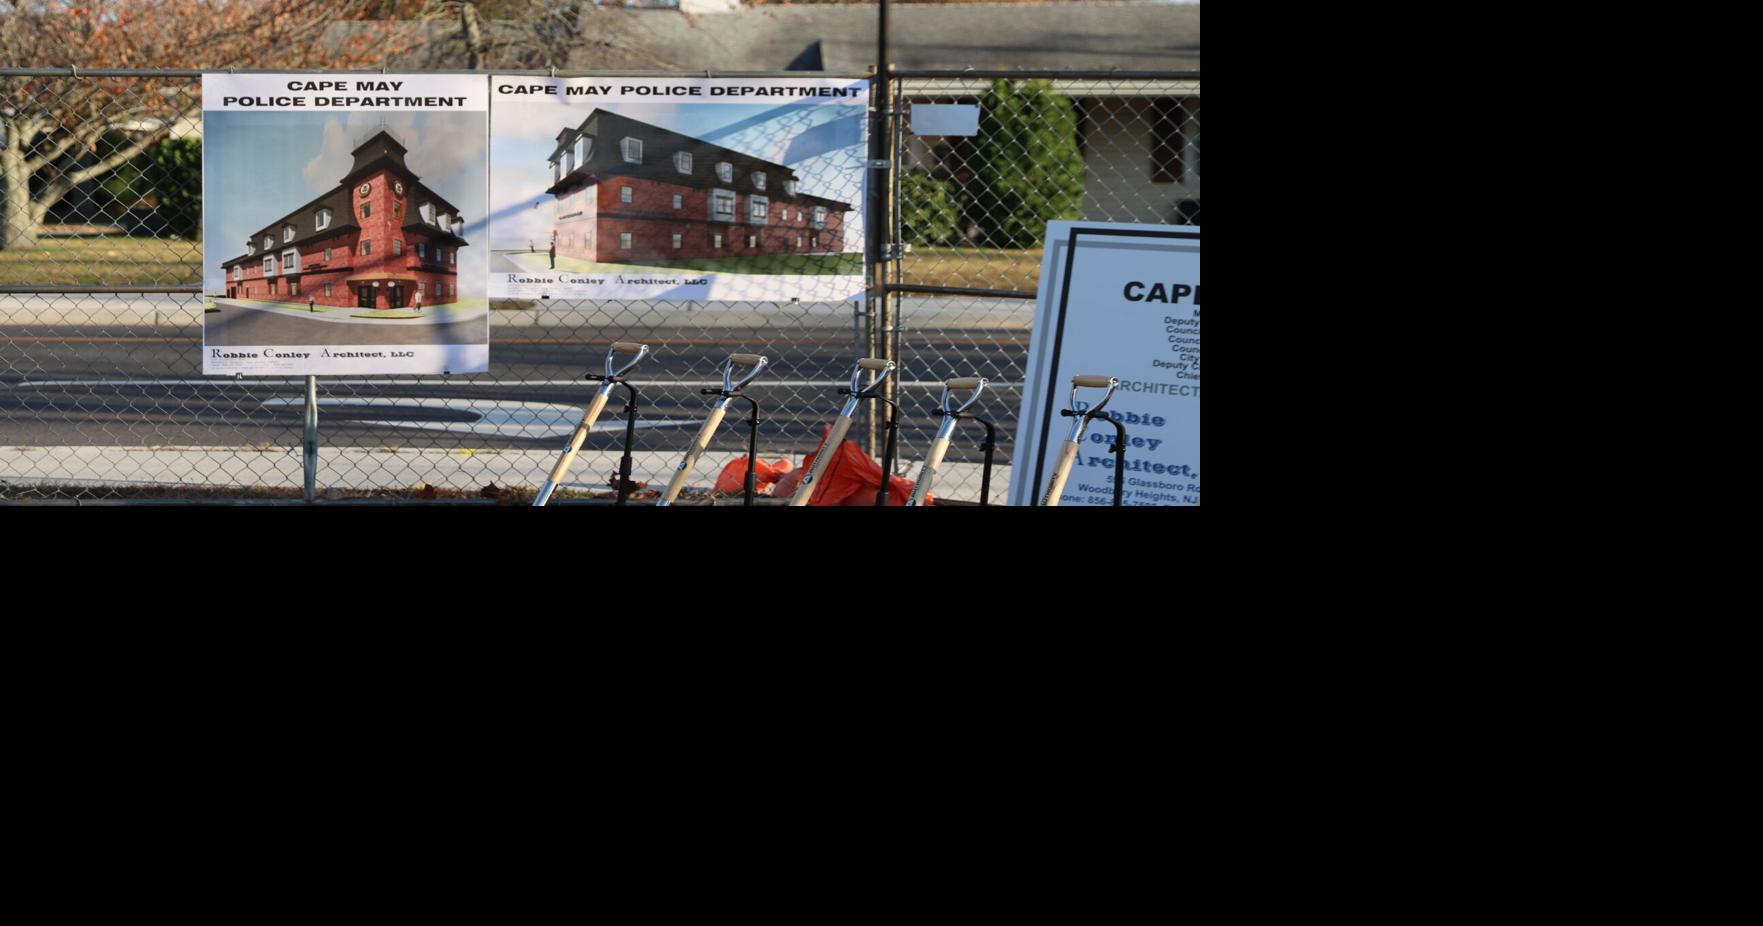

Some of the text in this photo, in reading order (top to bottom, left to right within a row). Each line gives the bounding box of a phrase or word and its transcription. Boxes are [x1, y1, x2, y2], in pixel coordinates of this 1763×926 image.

[287, 81, 403, 91] CAPE MAY
[498, 84, 862, 98] CAPE MAY POLICE DEPARTMENT
[223, 96, 467, 107] POLICE DEPARTMENT
[508, 274, 554, 284] Robbie
[558, 274, 605, 285] Conley
[1164, 316, 1200, 327] Deputy
[212, 349, 258, 359] Robbie
[263, 349, 310, 360] Conley
[1152, 359, 1189, 370] Deputy
[1078, 433, 1162, 451] onley
[1128, 477, 1184, 491] Glassboro
[1078, 484, 1133, 498] Woodbry
